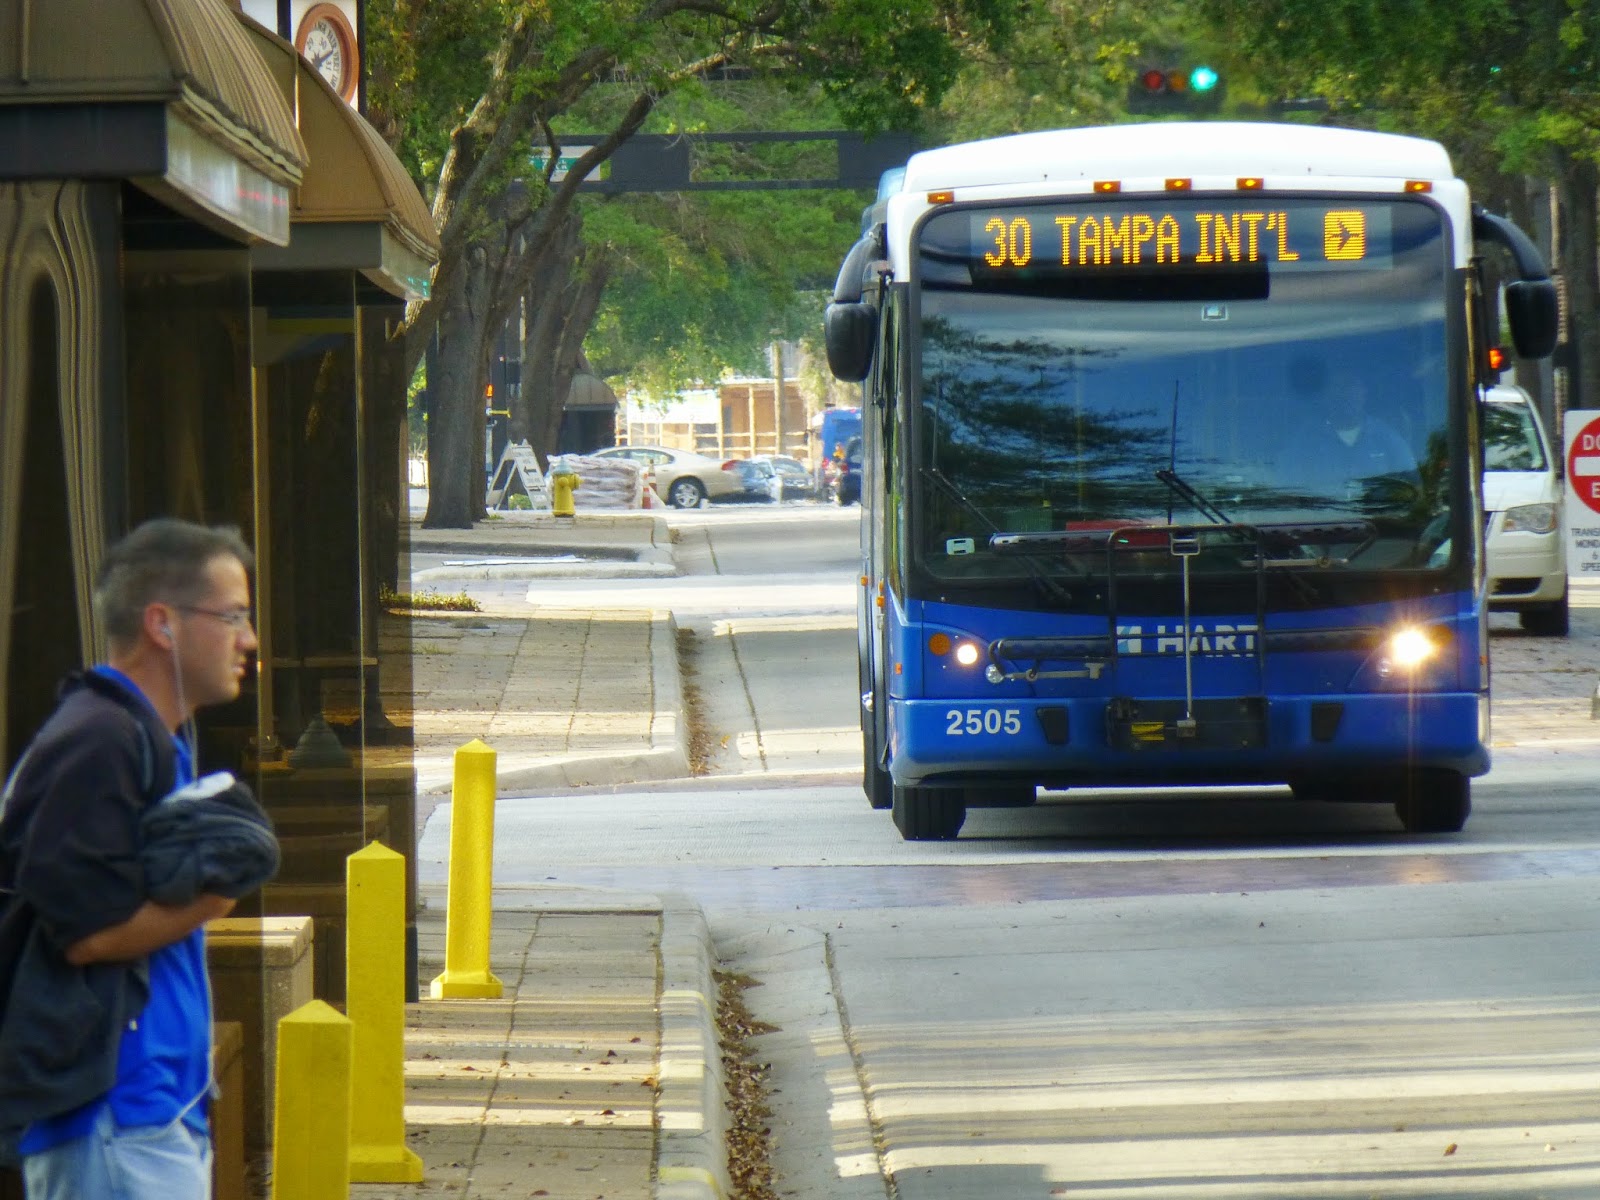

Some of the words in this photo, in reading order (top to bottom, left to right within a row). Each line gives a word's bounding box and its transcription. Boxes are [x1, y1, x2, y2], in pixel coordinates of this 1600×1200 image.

[984, 216, 1031, 267] 30
[1055, 213, 1180, 266] TAMPA
[1193, 211, 1300, 264] INT'L
[1157, 625, 1259, 657] HART
[946, 709, 1021, 735] 2505
